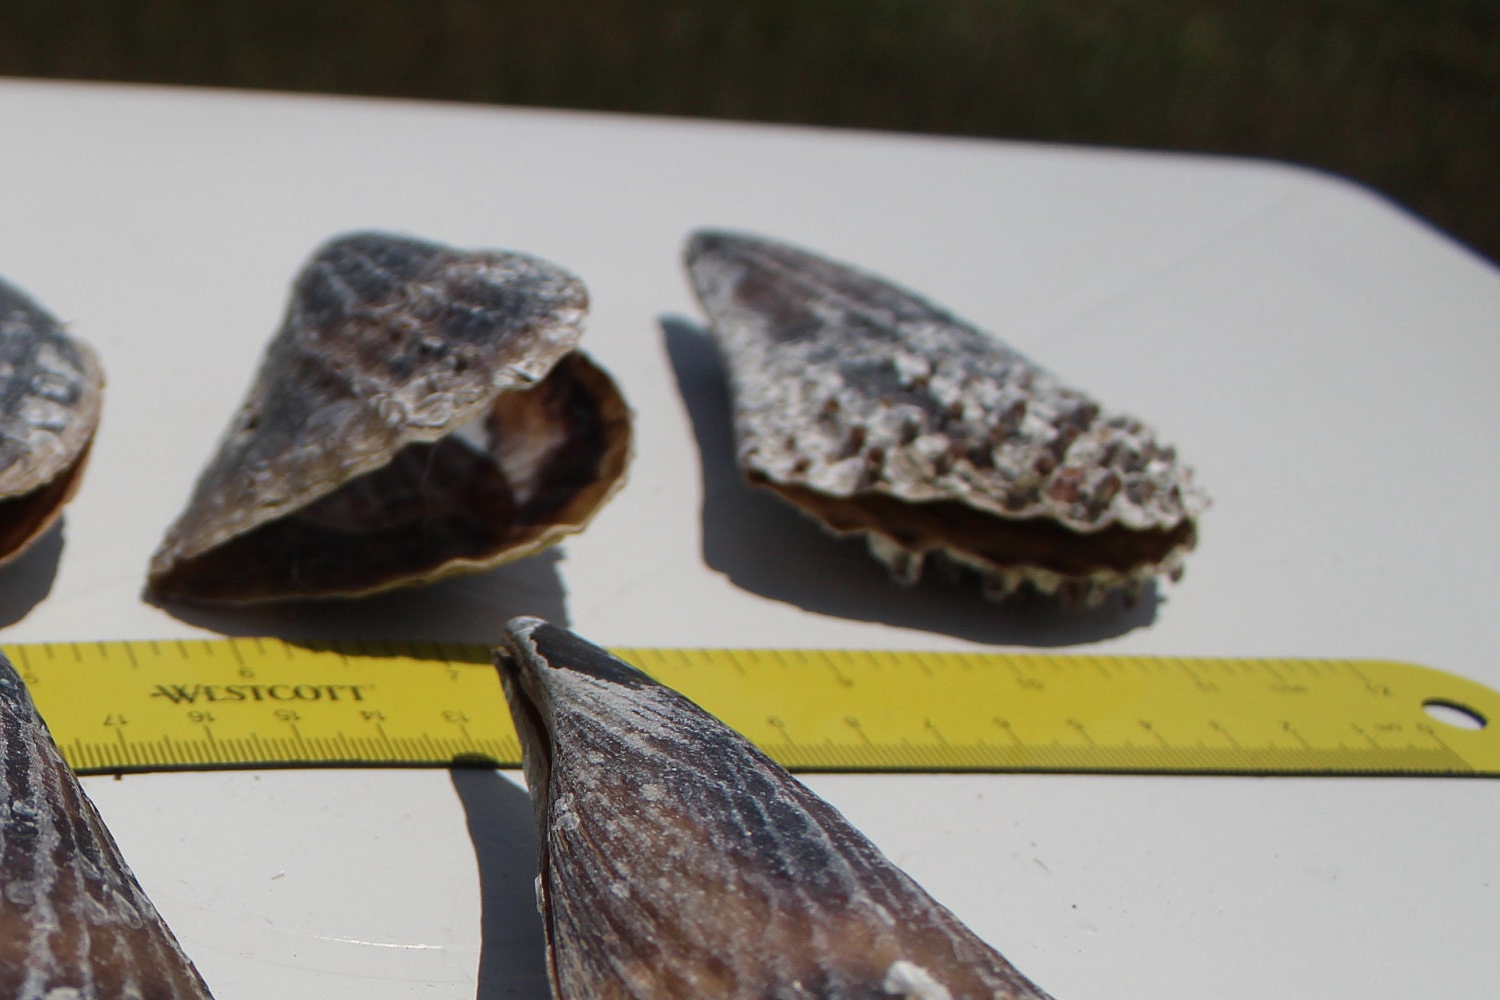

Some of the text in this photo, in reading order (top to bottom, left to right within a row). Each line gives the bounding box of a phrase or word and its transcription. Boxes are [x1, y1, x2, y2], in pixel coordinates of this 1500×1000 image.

[23, 671, 39, 685] 5
[238, 666, 255, 679] 6
[151, 684, 367, 704] WESTCOTT
[103, 713, 128, 726] 17
[187, 709, 216, 723] 16
[273, 708, 302, 722] 15
[440, 709, 469, 723] 13
